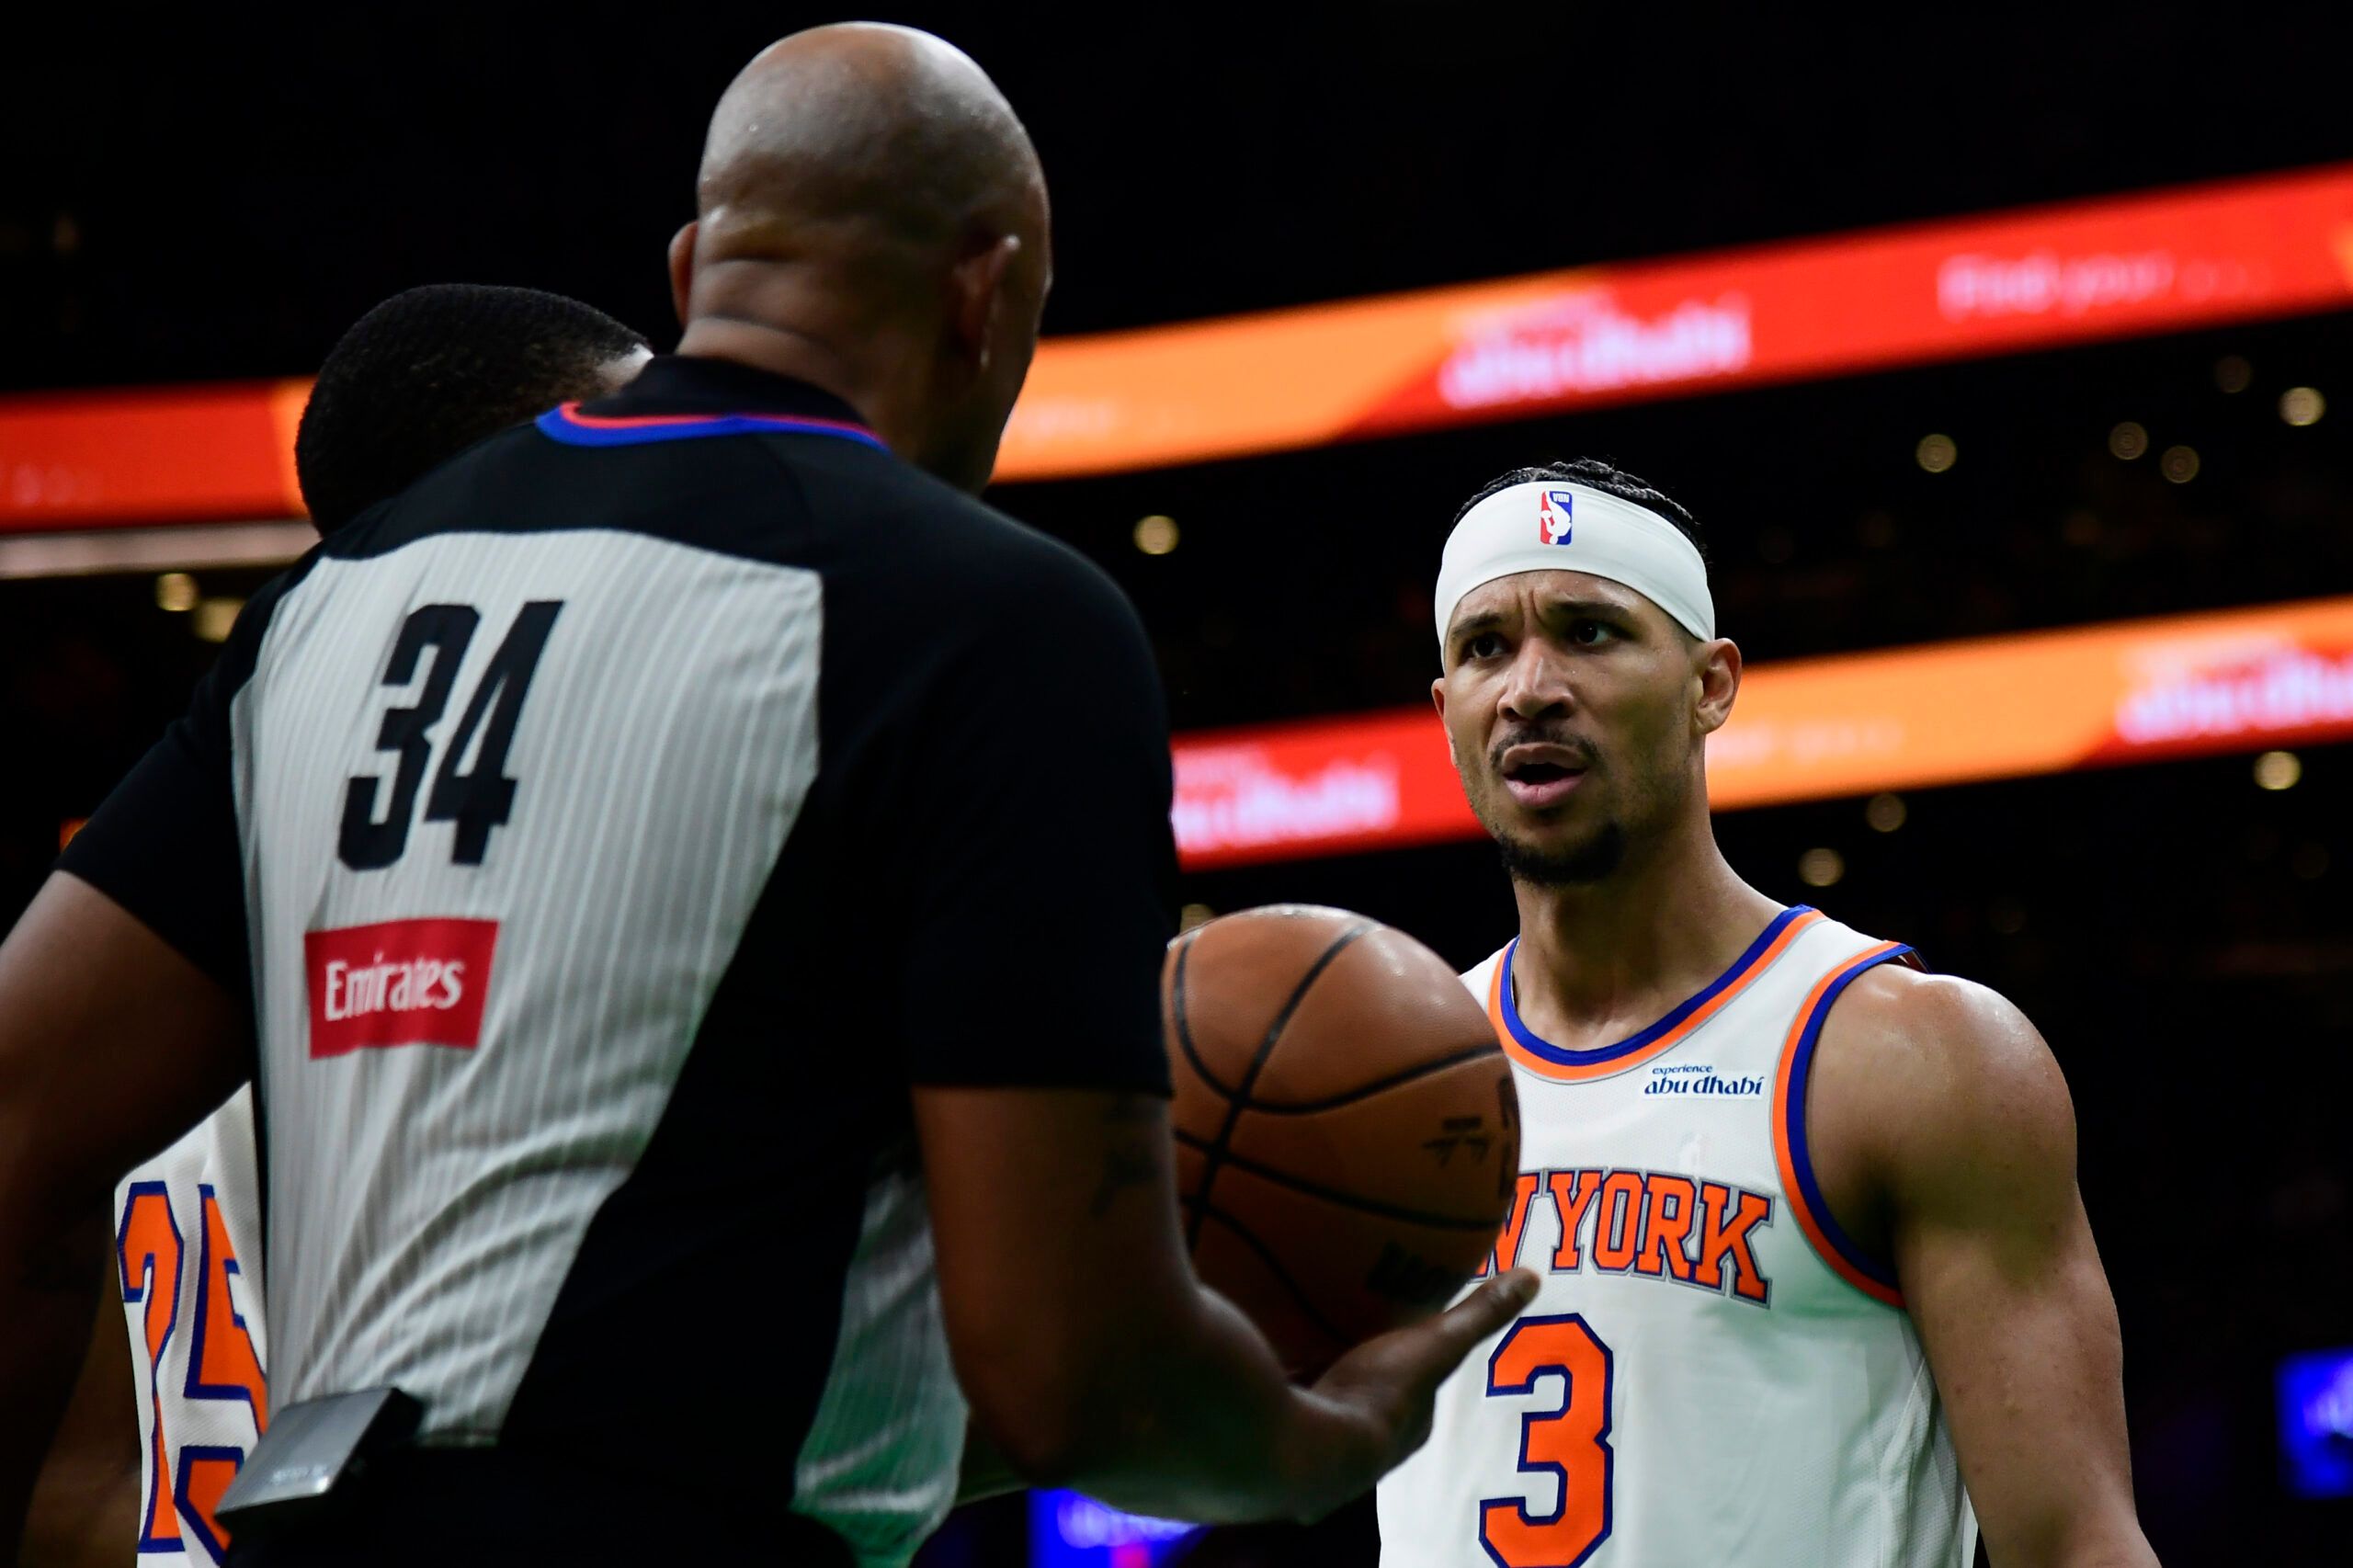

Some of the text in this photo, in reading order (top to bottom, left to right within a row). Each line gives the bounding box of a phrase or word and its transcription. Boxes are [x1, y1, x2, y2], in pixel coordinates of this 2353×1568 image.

[337, 600, 564, 871] 34
[324, 950, 466, 1022] Emirates
[1644, 1075, 1765, 1095] abu dhabi
[1652, 1063, 1713, 1076] experience
[1546, 1167, 1774, 1310] YORK
[117, 1181, 270, 1568] 25
[1479, 1312, 1613, 1568] 3
